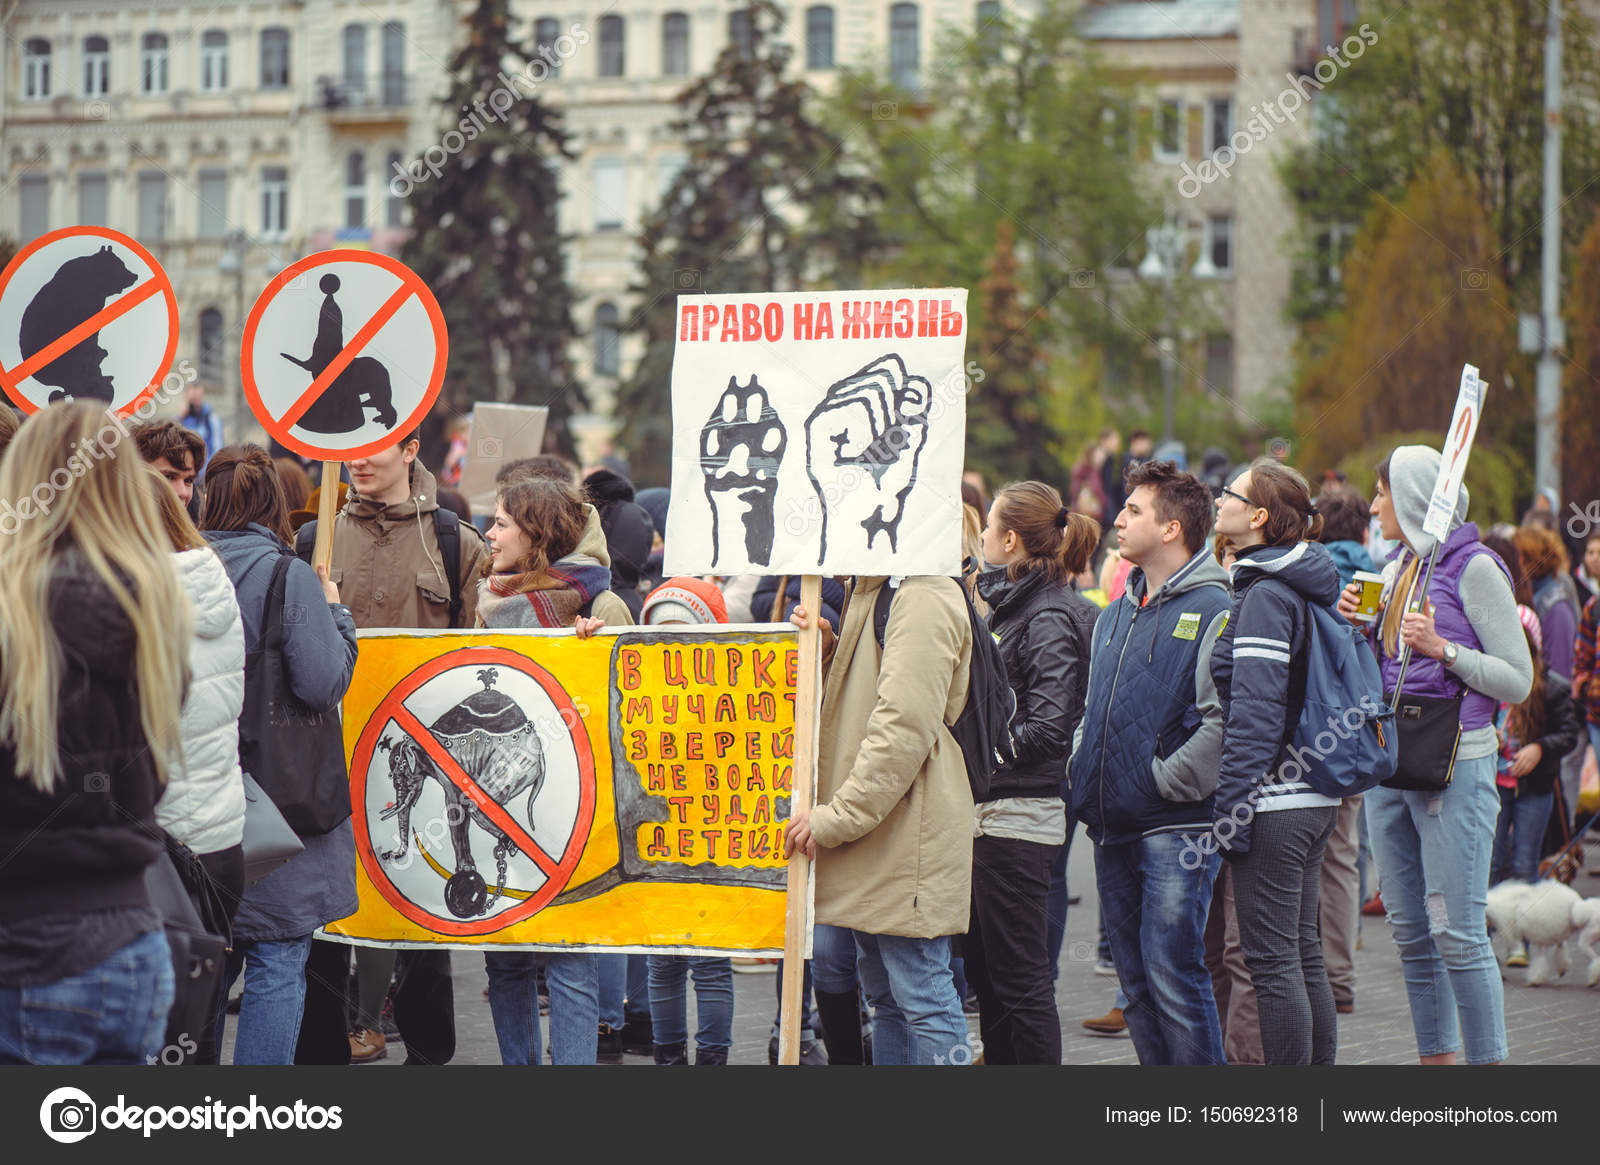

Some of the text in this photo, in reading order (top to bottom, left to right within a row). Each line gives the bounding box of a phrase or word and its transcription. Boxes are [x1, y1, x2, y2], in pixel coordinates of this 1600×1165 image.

[680, 298, 963, 342] ПРАВО НА ЖИЗНЬ
[621, 648, 799, 690] В ЦИРКЕ
[631, 727, 795, 761] ЗВЕРЕЙ
[648, 764, 687, 790] НЕ
[668, 795, 770, 824] ТУДА
